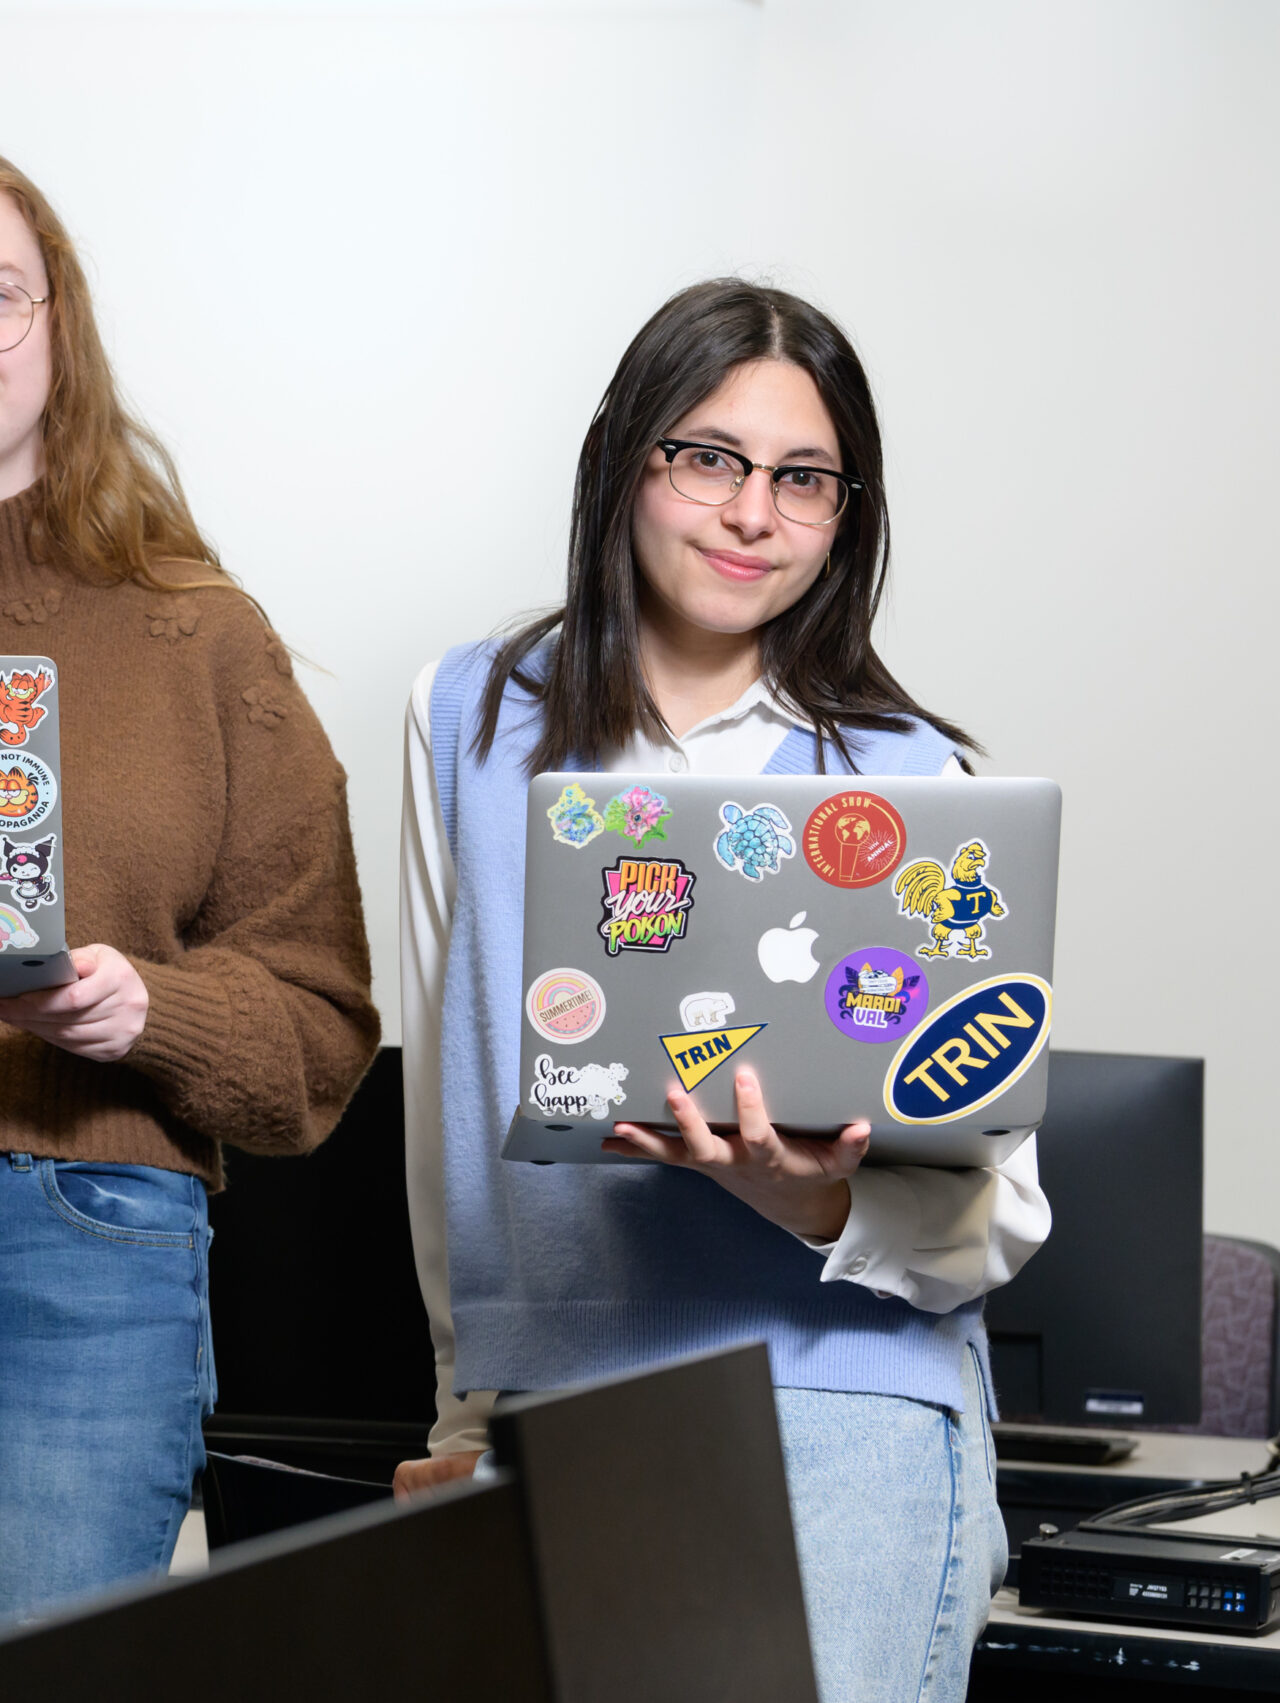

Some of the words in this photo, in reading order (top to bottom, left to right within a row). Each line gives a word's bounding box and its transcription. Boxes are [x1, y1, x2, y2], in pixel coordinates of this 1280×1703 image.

[1, 753, 22, 761] NOT
[22, 756, 50, 786] IMMUNE
[808, 802, 838, 877] INTERNATIONAL
[841, 796, 871, 808] SHOW
[867, 839, 894, 862] ANNUAL
[620, 861, 678, 894] PICK
[602, 888, 689, 934] your
[966, 891, 987, 915] T
[608, 911, 683, 952] POISON
[539, 990, 593, 1023] SUMMERTIME!
[846, 991, 901, 1013] MARDI
[854, 1008, 887, 1027] VAL
[674, 1033, 733, 1070] TRIN
[903, 991, 1036, 1103] TRIN
[539, 1058, 581, 1086] bee
